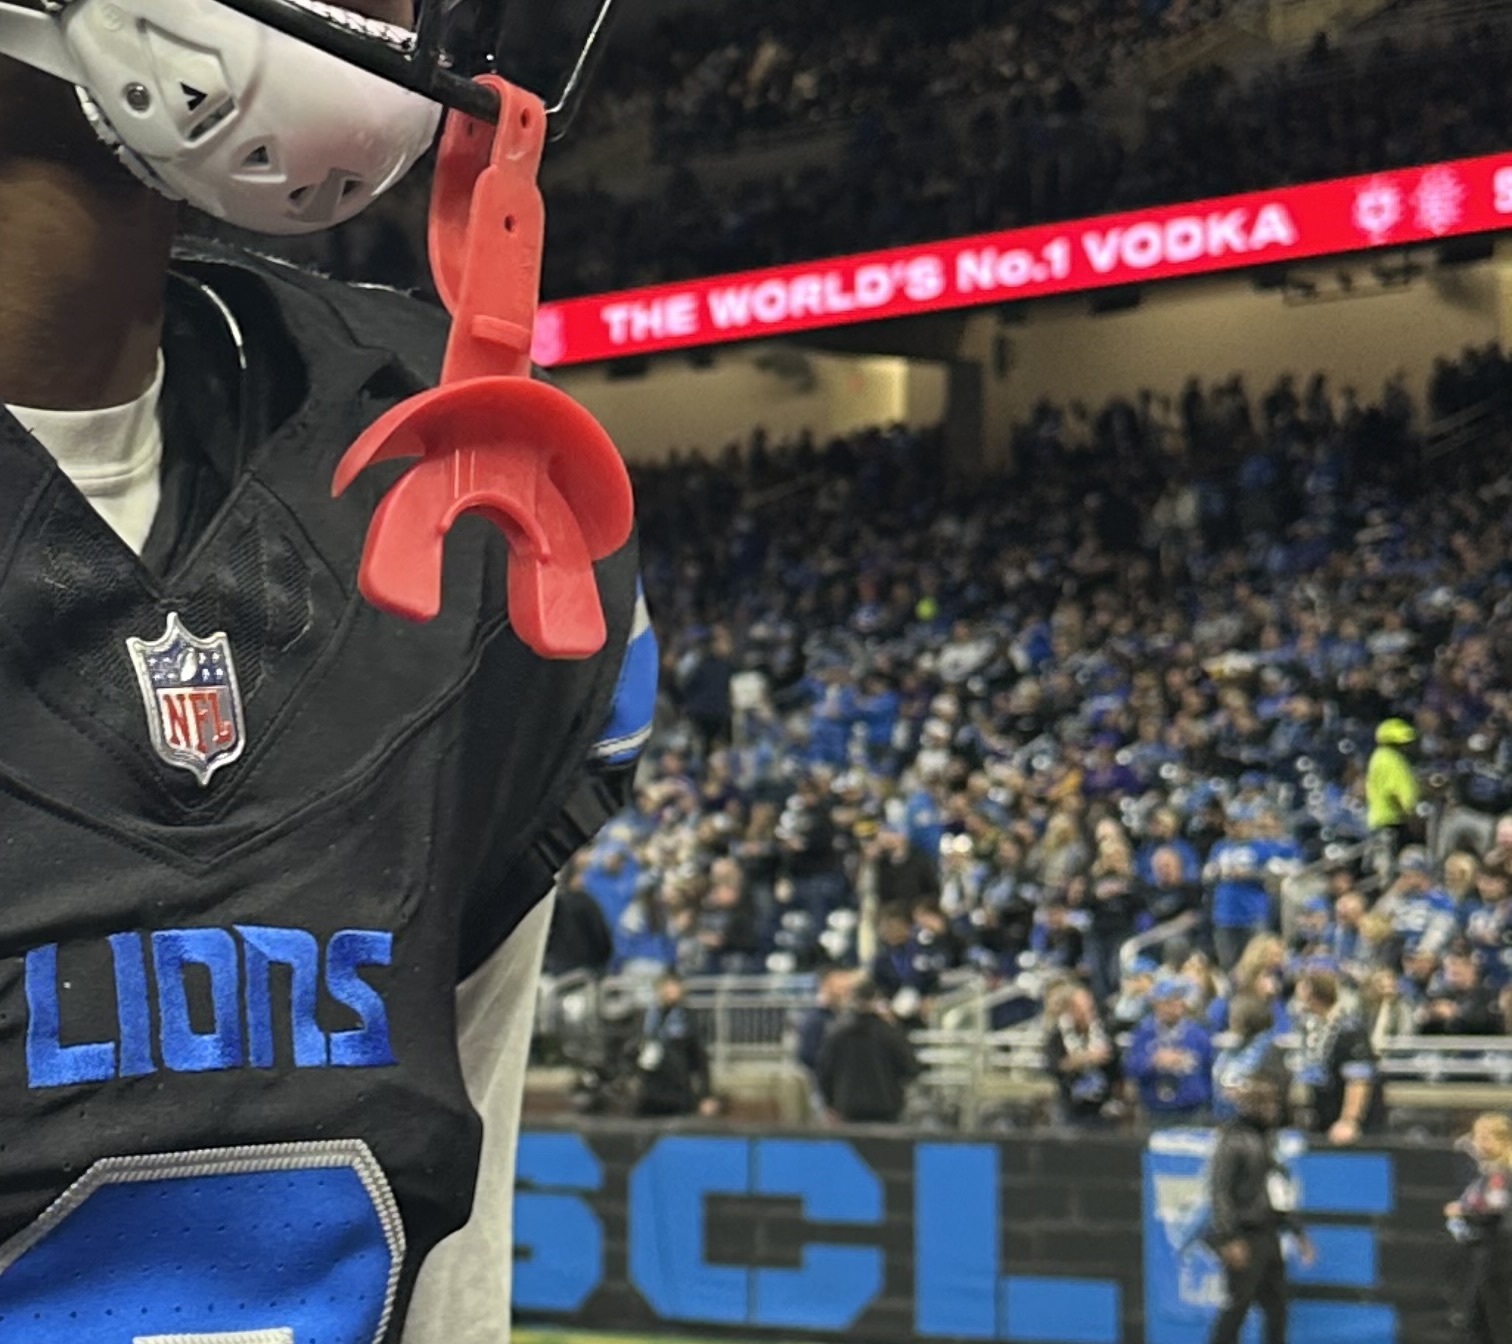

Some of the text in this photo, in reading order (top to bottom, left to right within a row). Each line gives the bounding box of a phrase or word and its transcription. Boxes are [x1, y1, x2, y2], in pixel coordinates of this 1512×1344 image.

[600, 297, 698, 346] THE
[708, 254, 944, 328] WORLD'S
[958, 237, 1071, 296] No.1
[1083, 202, 1294, 275] VODKA
[162, 690, 234, 754] NFL
[25, 923, 399, 1089] LIONS
